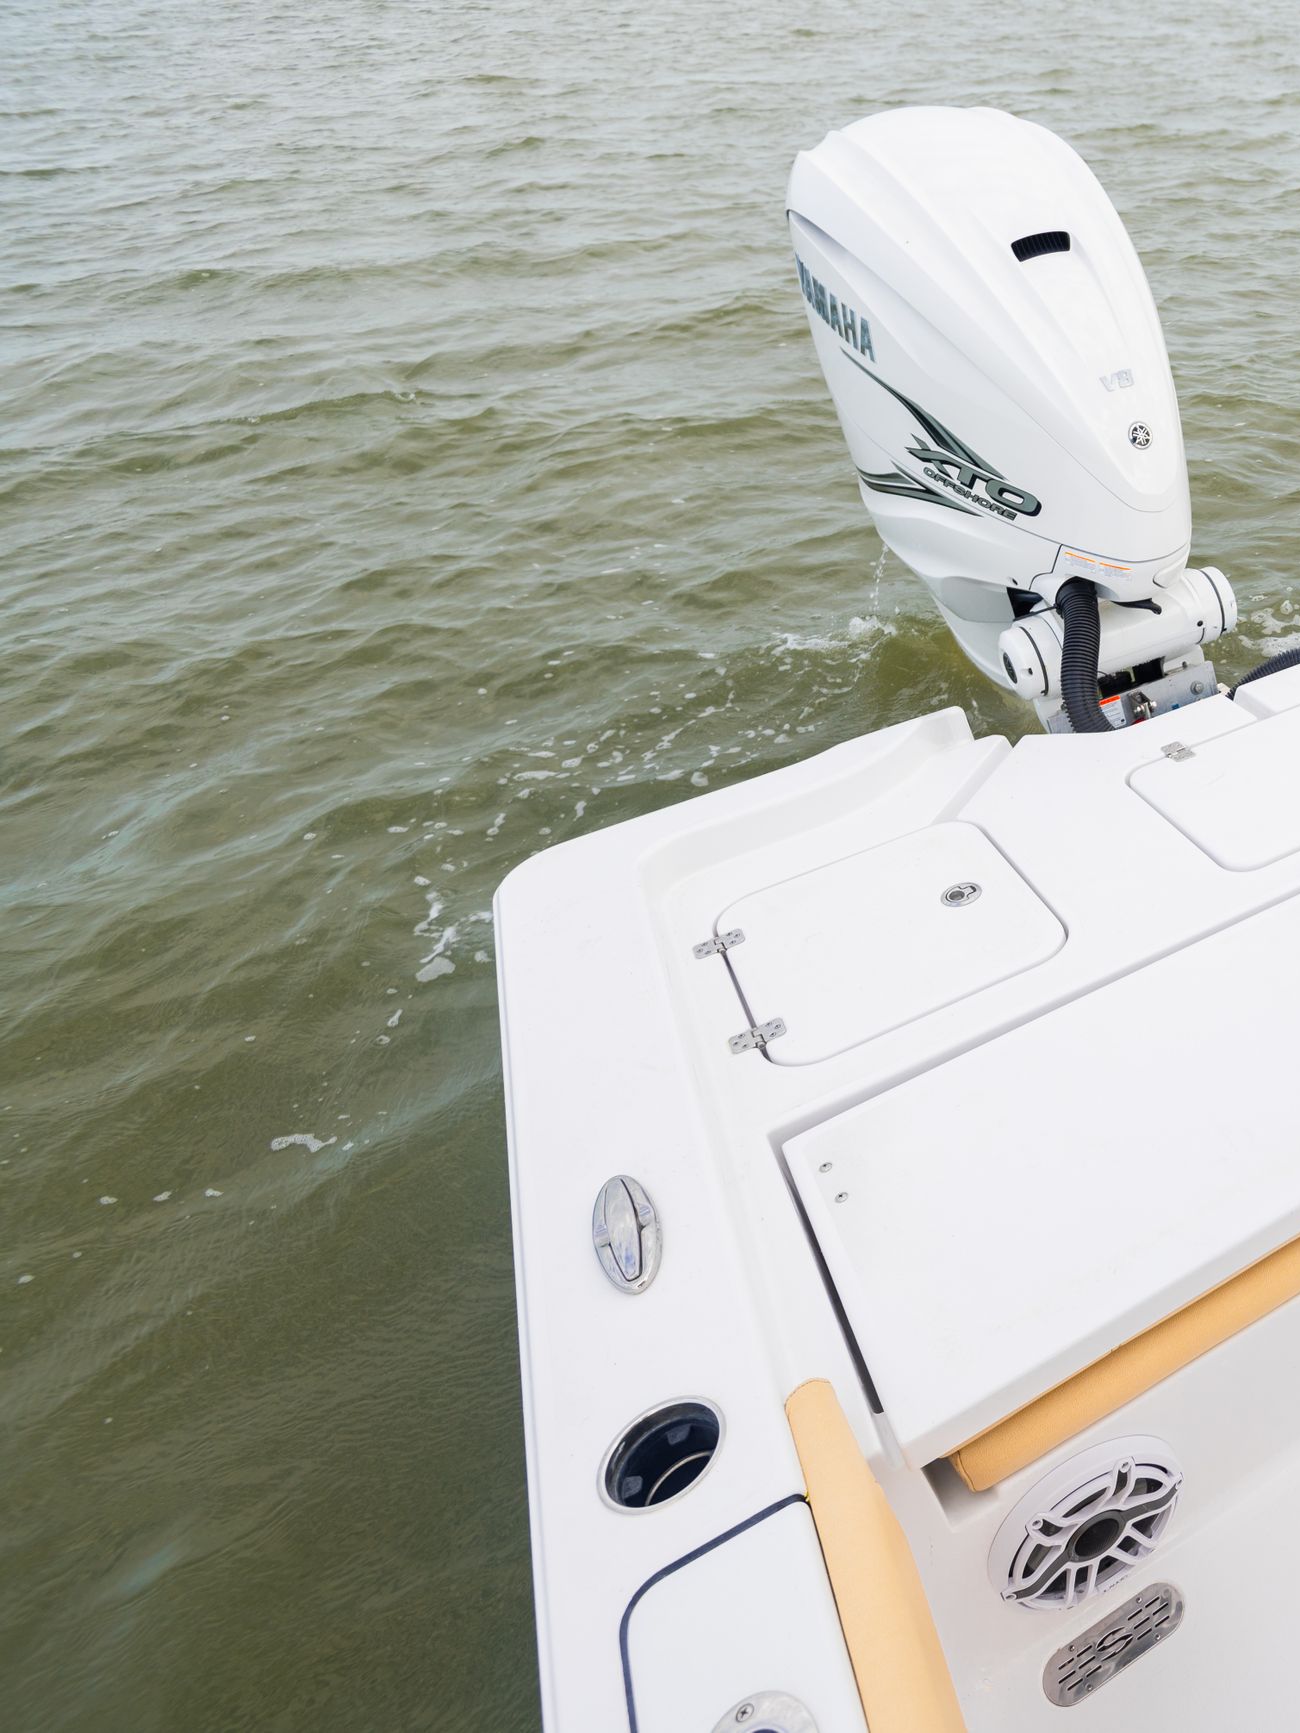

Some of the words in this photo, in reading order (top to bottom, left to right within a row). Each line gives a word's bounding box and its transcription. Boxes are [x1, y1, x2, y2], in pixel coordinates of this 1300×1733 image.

[795, 252, 876, 362] YAMAHA
[905, 433, 1042, 516] XTO
[922, 466, 1018, 521] OFFSHORE
